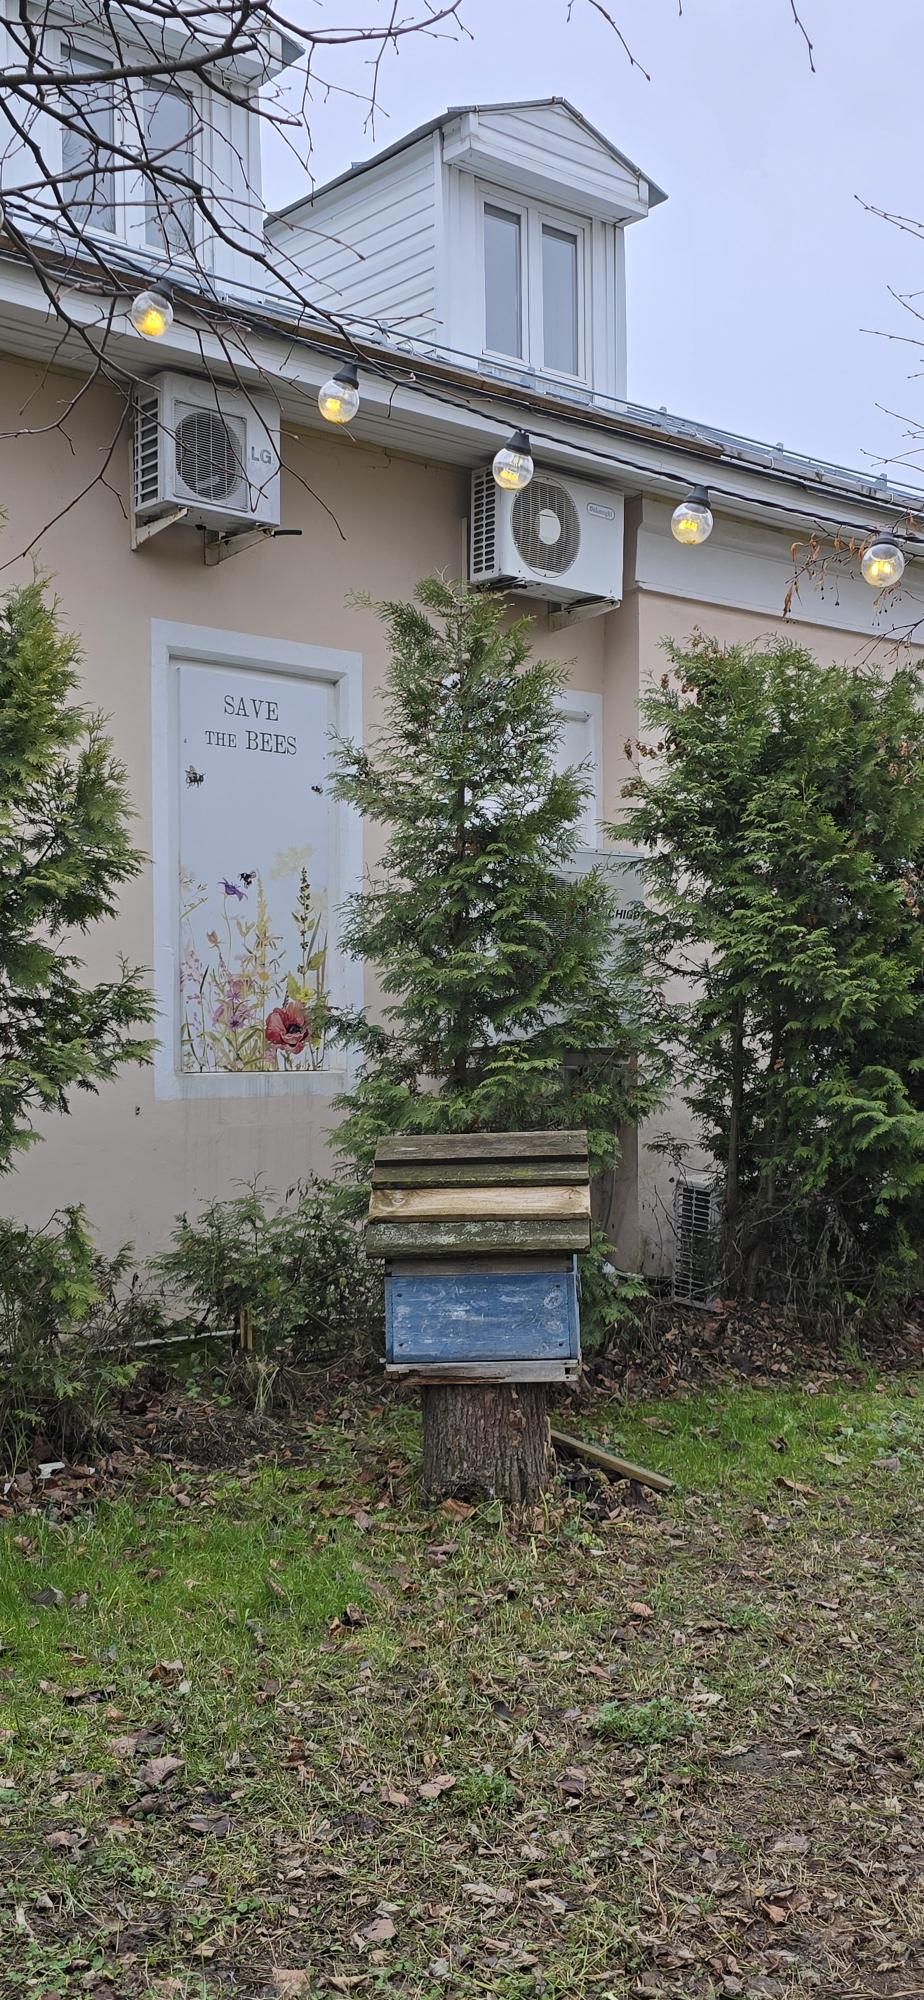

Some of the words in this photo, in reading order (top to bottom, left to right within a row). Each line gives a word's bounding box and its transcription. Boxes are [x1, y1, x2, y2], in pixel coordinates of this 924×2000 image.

[251, 446, 272, 465] LG
[223, 694, 279, 721] SAVE
[204, 730, 237, 748] THE
[245, 730, 297, 756] BEES
